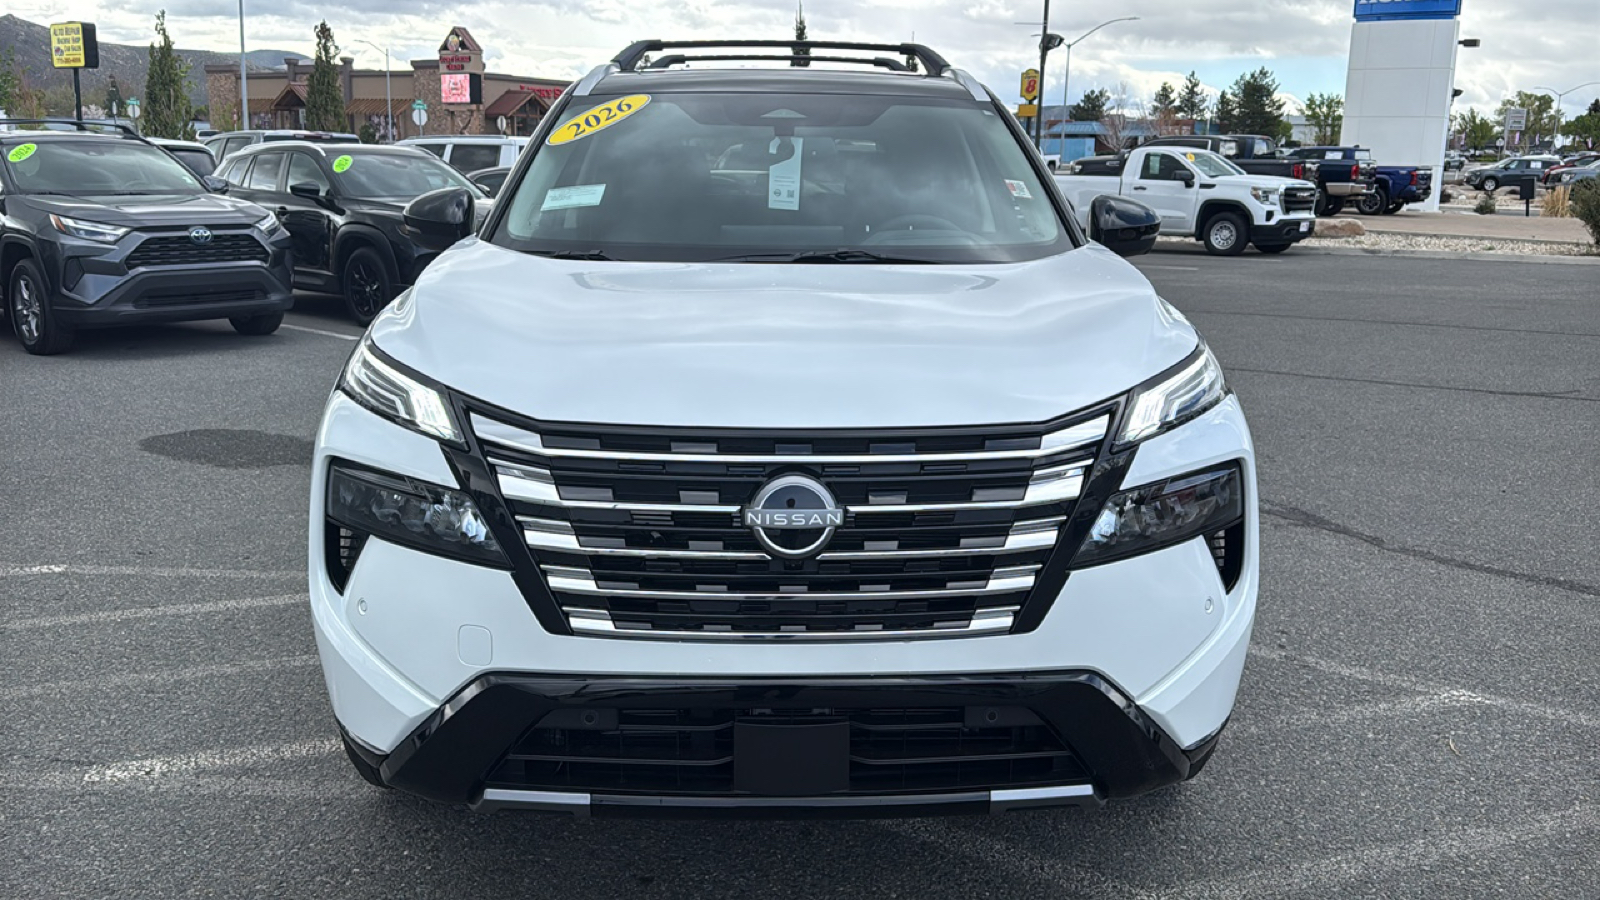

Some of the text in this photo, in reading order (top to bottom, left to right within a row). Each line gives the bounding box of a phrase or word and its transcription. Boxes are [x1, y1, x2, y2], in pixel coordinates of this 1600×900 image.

[1025, 79, 1037, 94] 8
[567, 99, 632, 138] 2026
[747, 512, 841, 525] NISSAN
